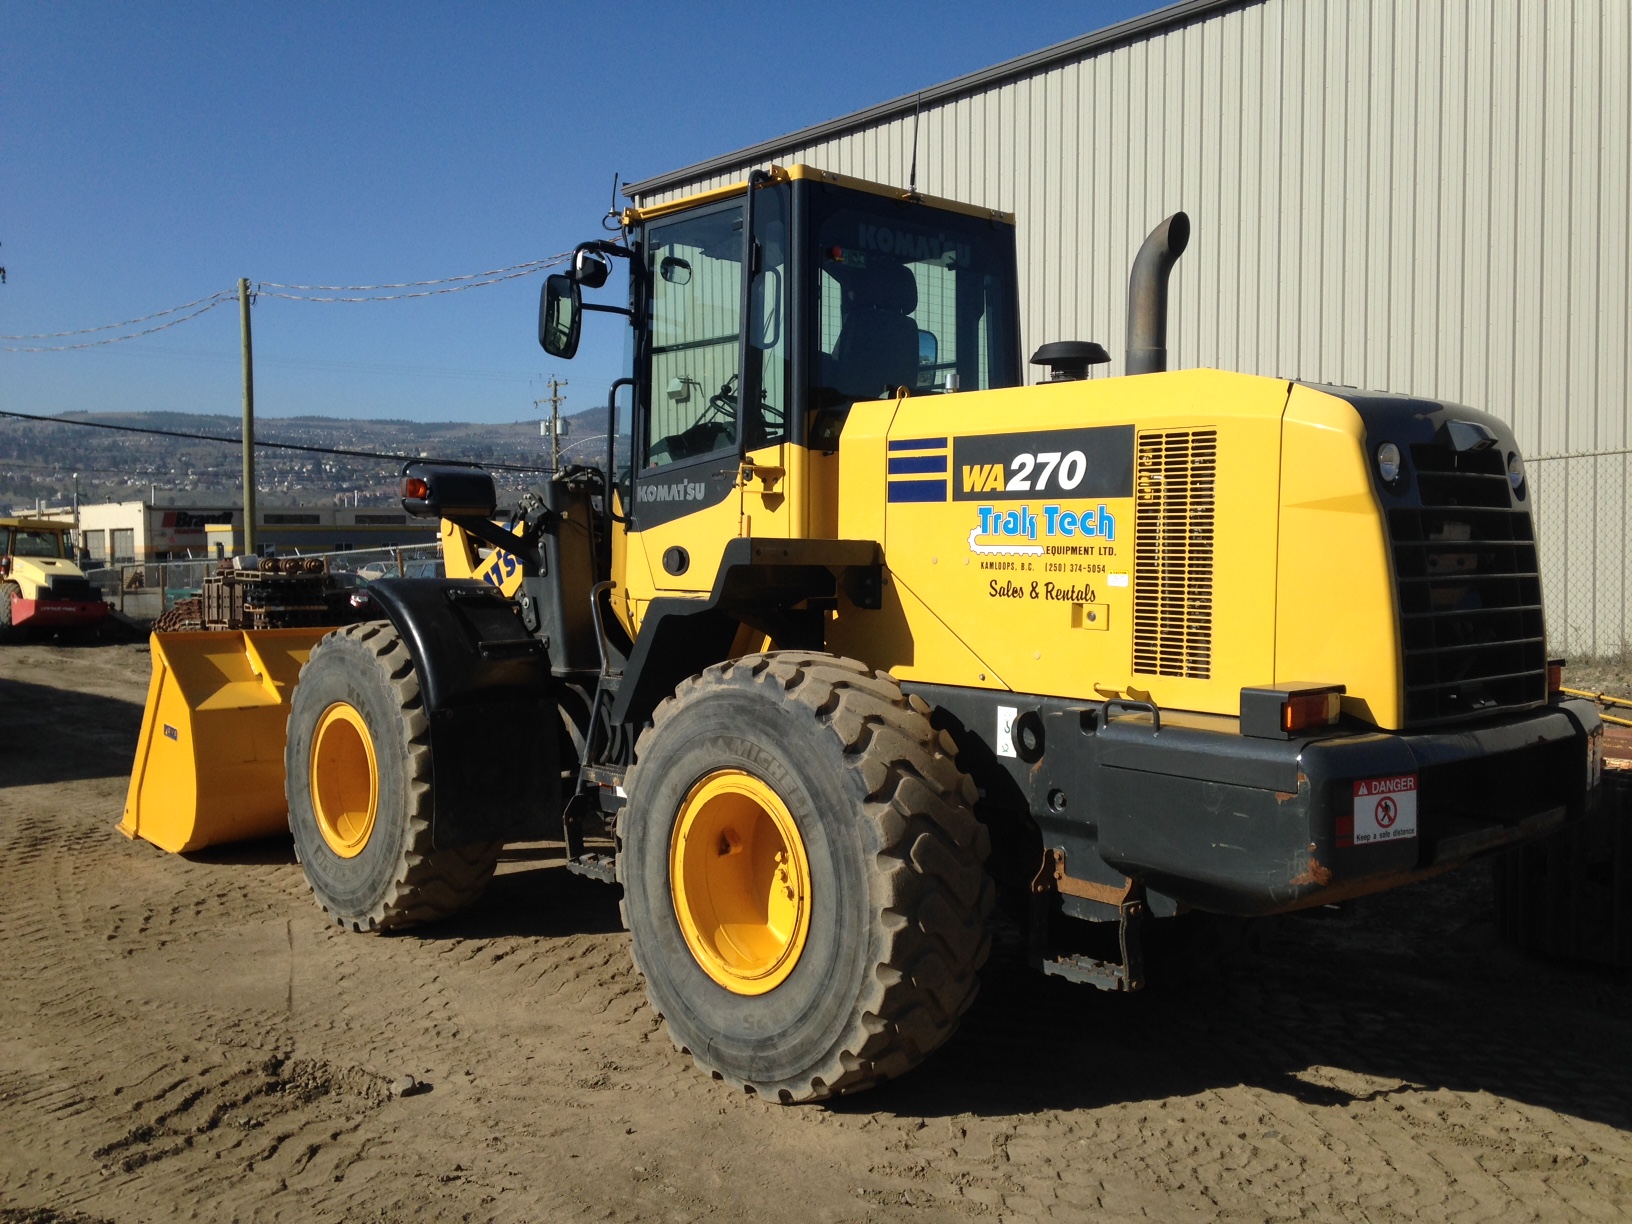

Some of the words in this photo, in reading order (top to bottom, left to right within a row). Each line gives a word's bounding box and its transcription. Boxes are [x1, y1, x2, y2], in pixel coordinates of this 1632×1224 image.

[637, 479, 705, 502] KOMATSU
[977, 505, 1039, 540] Trak
[1043, 504, 1115, 541] Tech
[1046, 546, 1095, 557] EQUIPMENT
[1098, 546, 1117, 557] LTD.
[980, 561, 1018, 572] KAMLOOPS,
[1020, 562, 1035, 572] B.C.
[1044, 562, 1066, 573] (250)
[1069, 564, 1106, 573] 374-5054
[989, 579, 1024, 599] Sales
[1029, 580, 1039, 600] &
[1044, 581, 1096, 603] Rentals
[1371, 778, 1415, 794] DANGER
[1356, 833, 1371, 843] Keep
[1379, 831, 1391, 840] safe
[1392, 828, 1415, 837] distance
